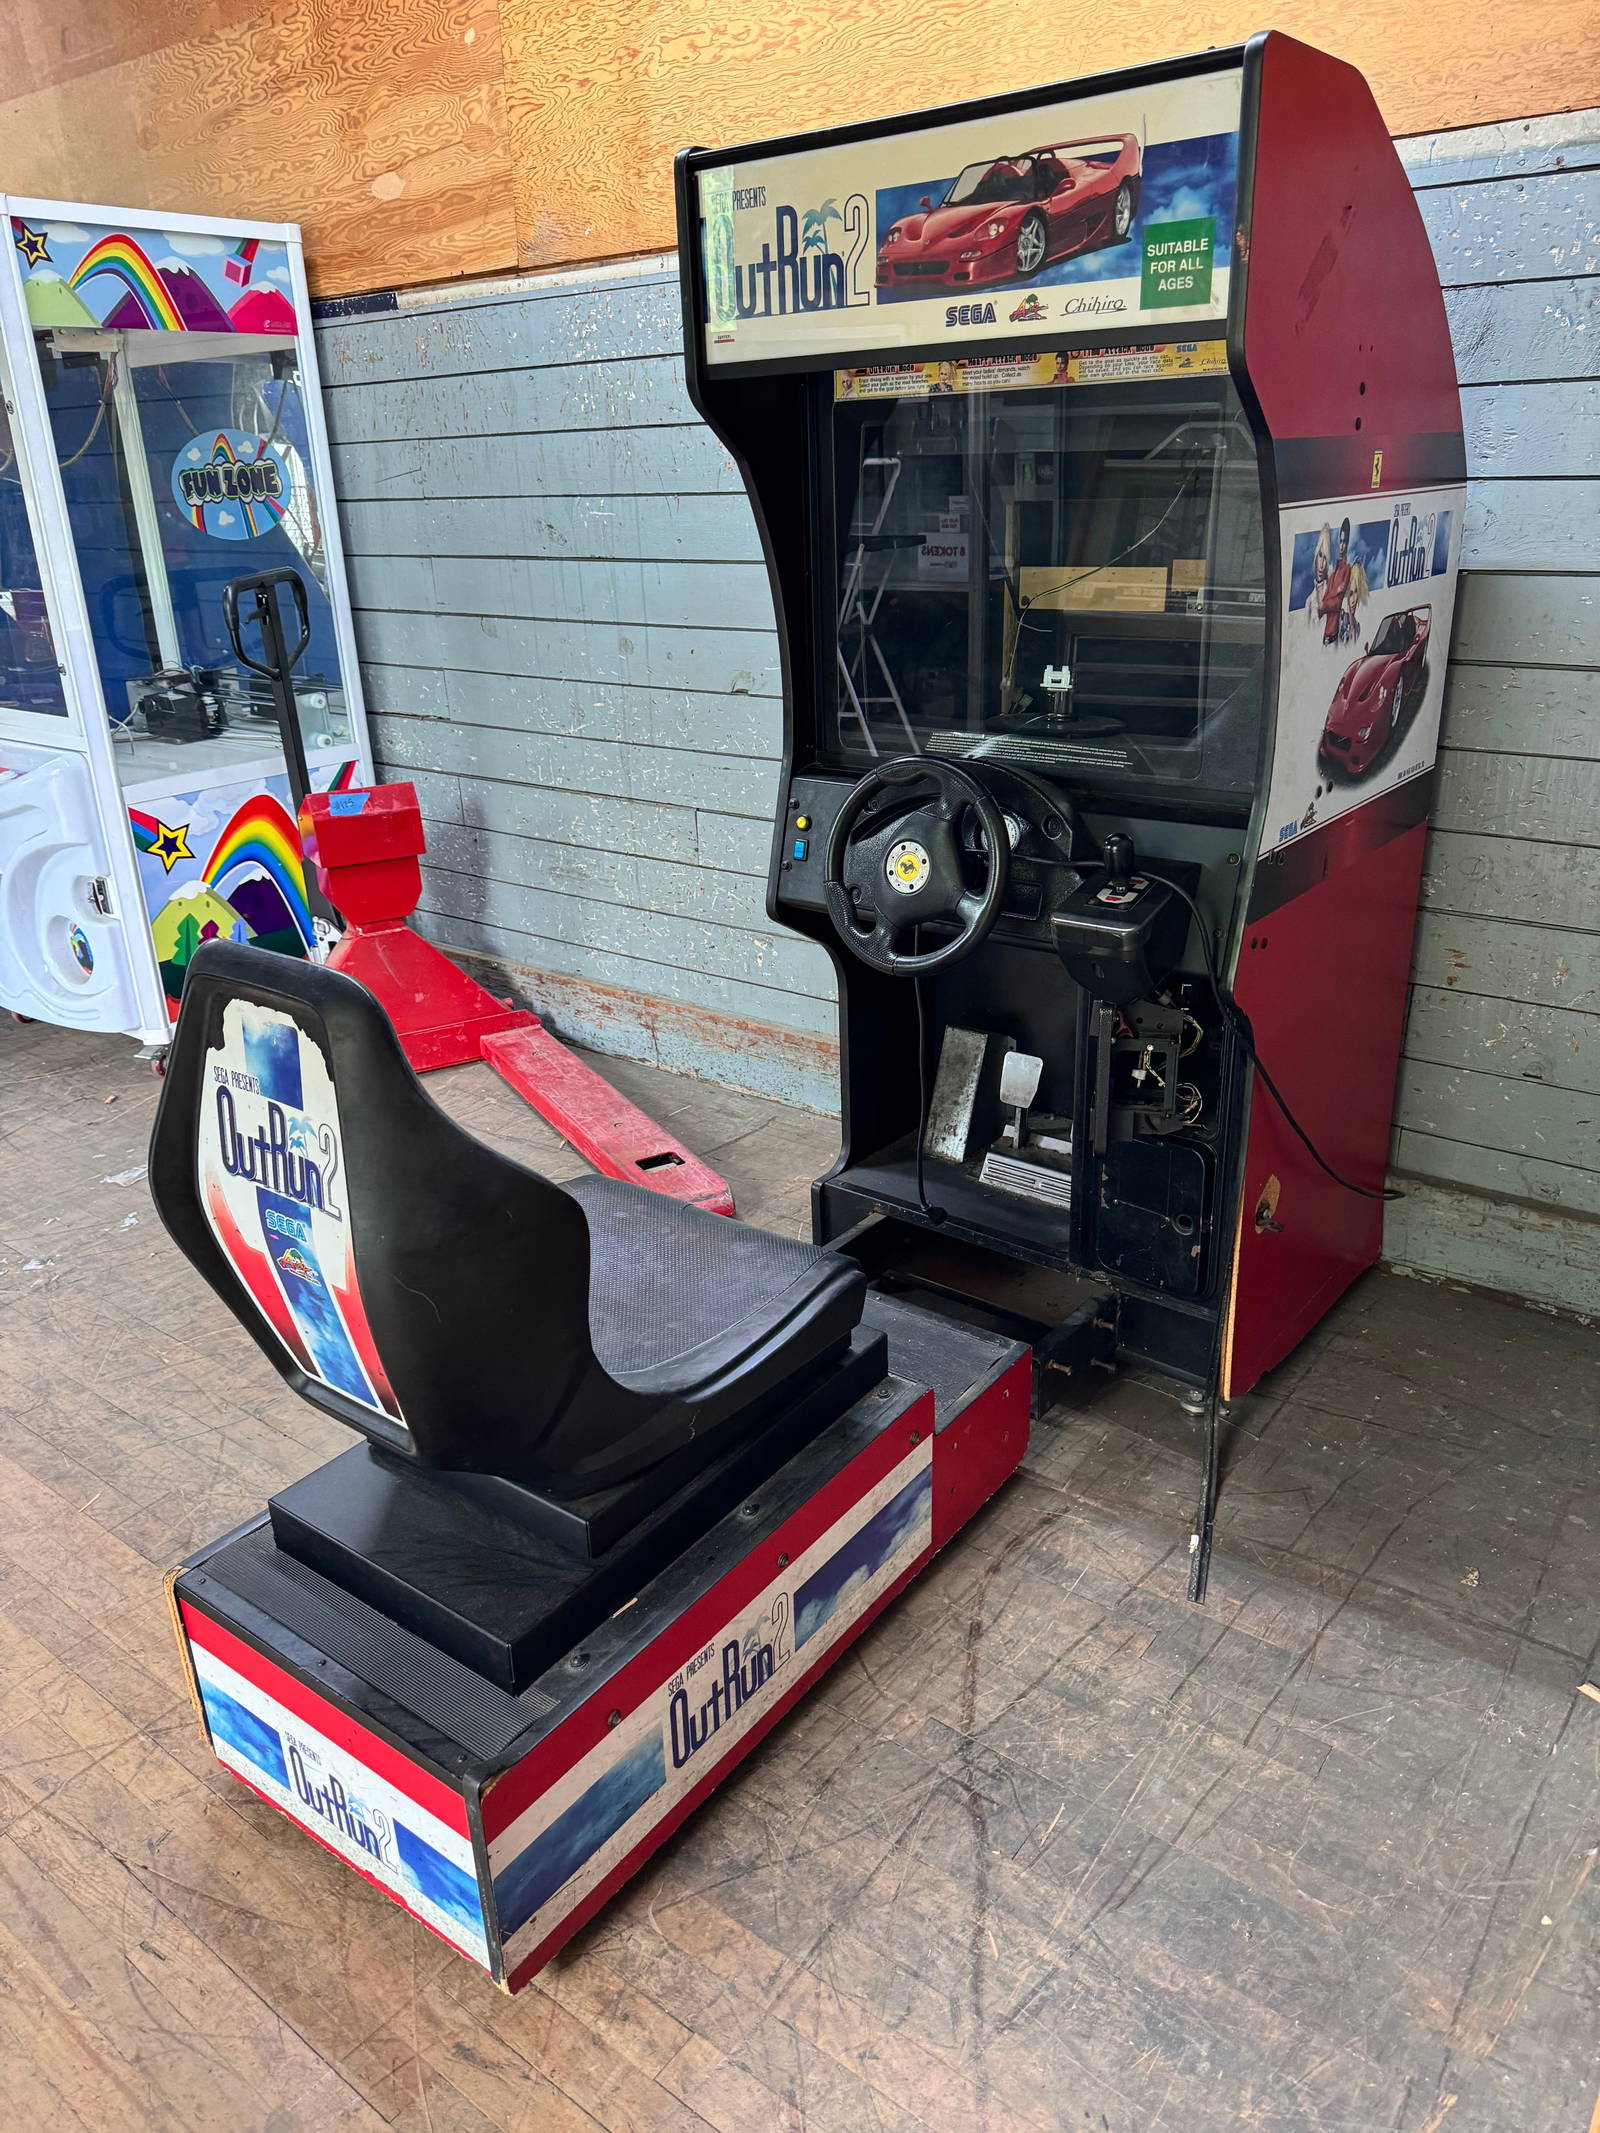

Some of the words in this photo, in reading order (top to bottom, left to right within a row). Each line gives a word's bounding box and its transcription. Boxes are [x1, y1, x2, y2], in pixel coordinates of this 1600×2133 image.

[733, 186, 766, 211] PRESENTS
[1147, 238, 1209, 257] SUITABLE
[1150, 260, 1176, 275] FOR
[1179, 257, 1204, 272] ALL
[1158, 276, 1194, 292] AGES
[946, 303, 997, 327] SEGA
[181, 468, 222, 500] FUN
[222, 464, 281, 499] ZONE
[214, 1065, 230, 1086] SEGA
[231, 1070, 260, 1095] PRESENTS
[265, 1208, 308, 1243] SEGA
[667, 1672, 685, 1698] SEGA
[686, 1642, 715, 1682] PRESENTS
